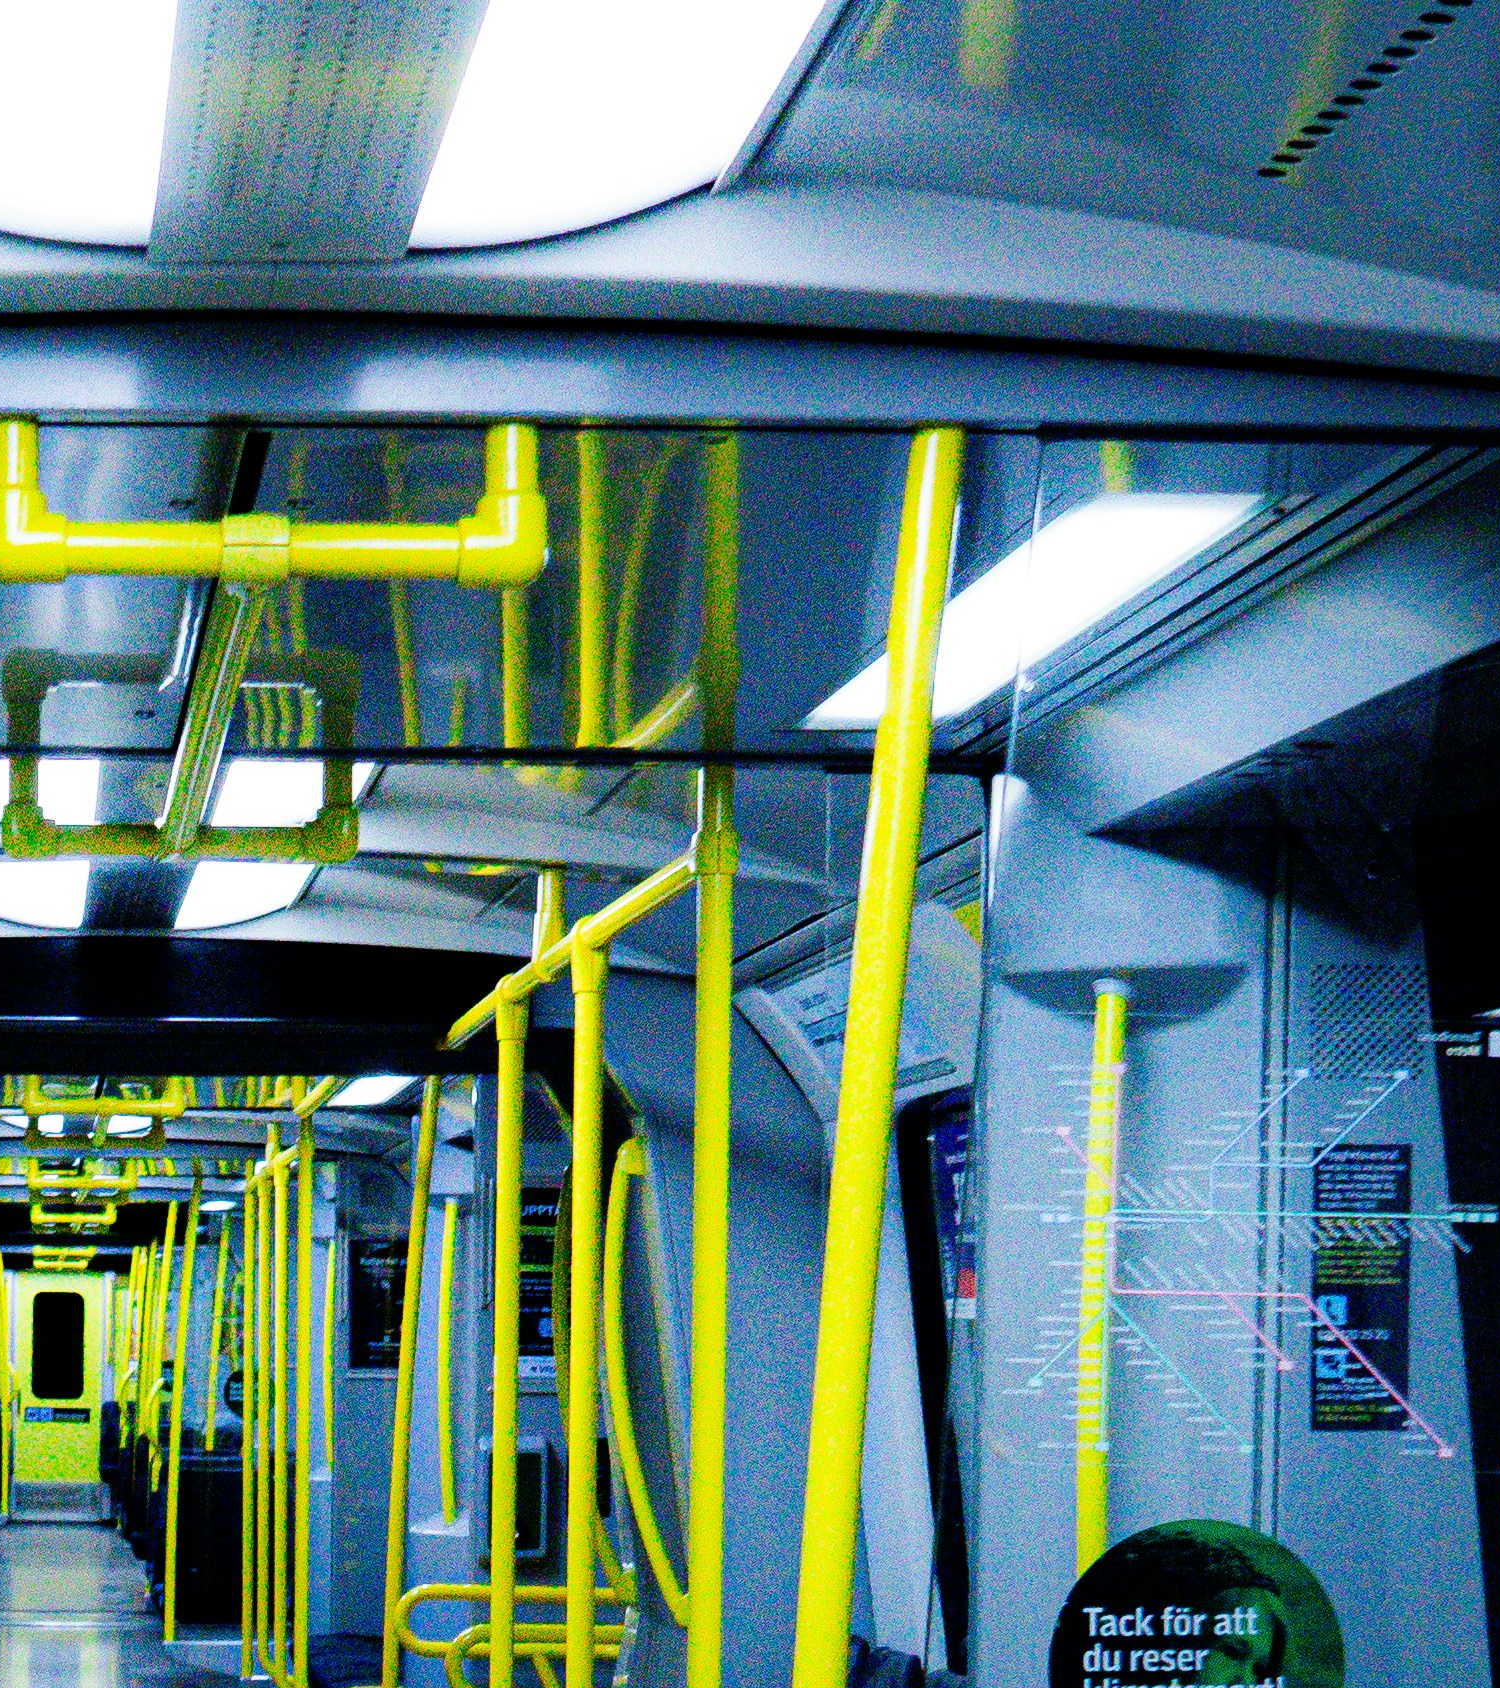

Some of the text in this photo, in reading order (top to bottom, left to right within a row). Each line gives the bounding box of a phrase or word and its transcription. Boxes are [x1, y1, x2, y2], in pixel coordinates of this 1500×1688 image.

[1082, 1604, 1259, 1637] Tack för att
[1082, 1642, 1210, 1673] du reser
